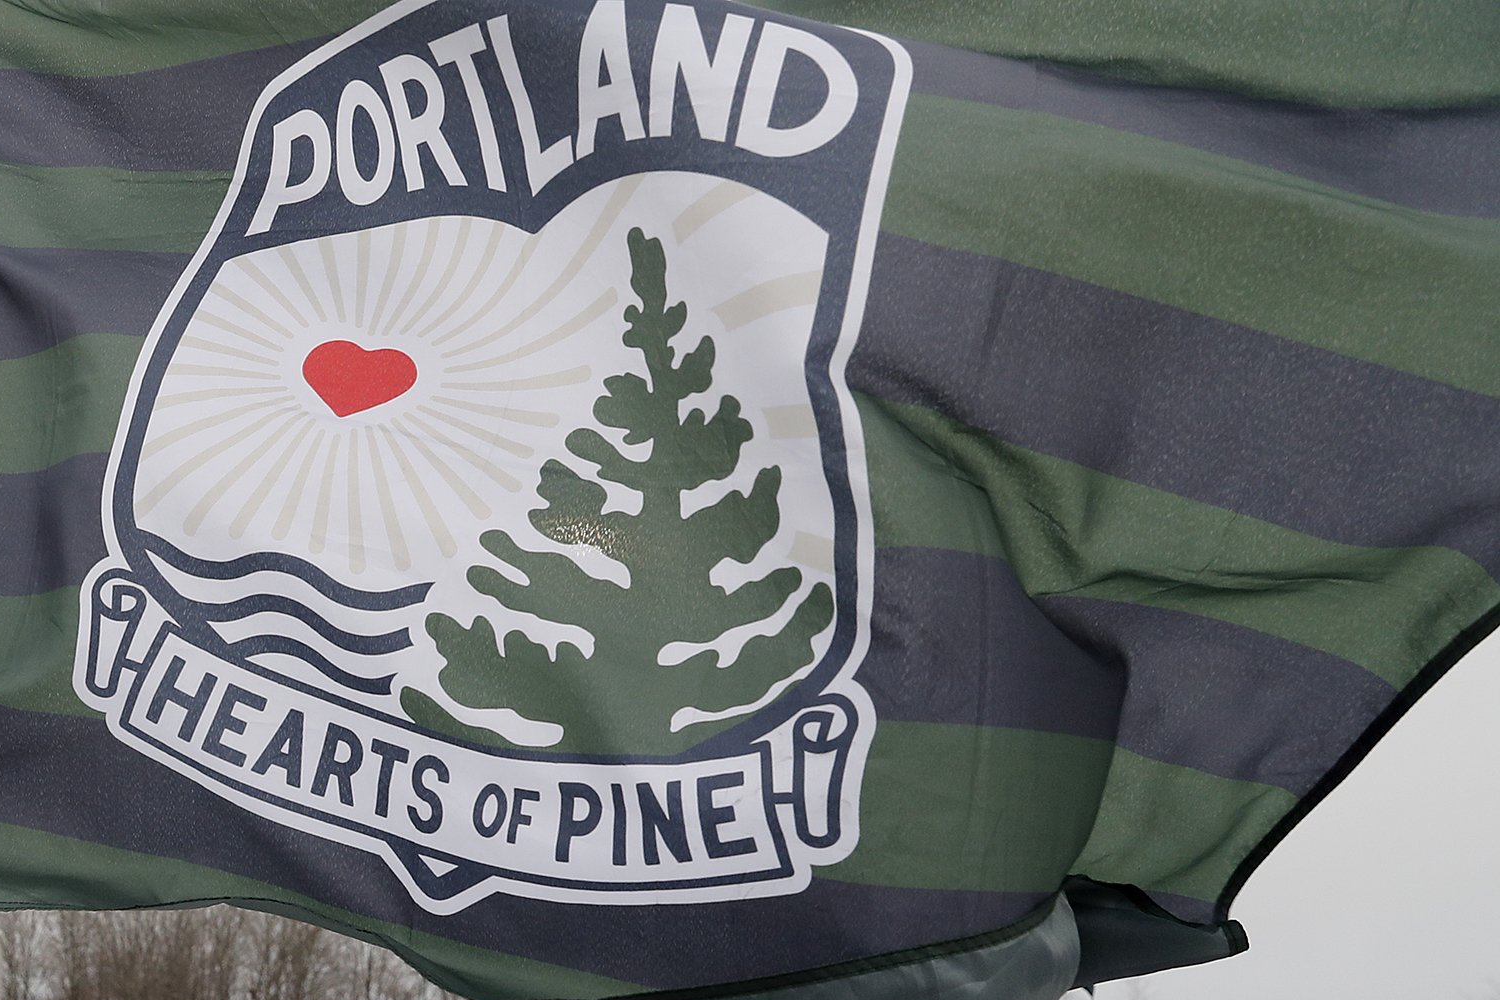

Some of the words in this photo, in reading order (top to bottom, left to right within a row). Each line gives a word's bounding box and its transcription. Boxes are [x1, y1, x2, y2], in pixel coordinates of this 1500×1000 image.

[245, 0, 858, 237] PORTLAND
[145, 653, 451, 835] HEARTS
[472, 783, 541, 845] OF
[556, 769, 759, 867] PINE
